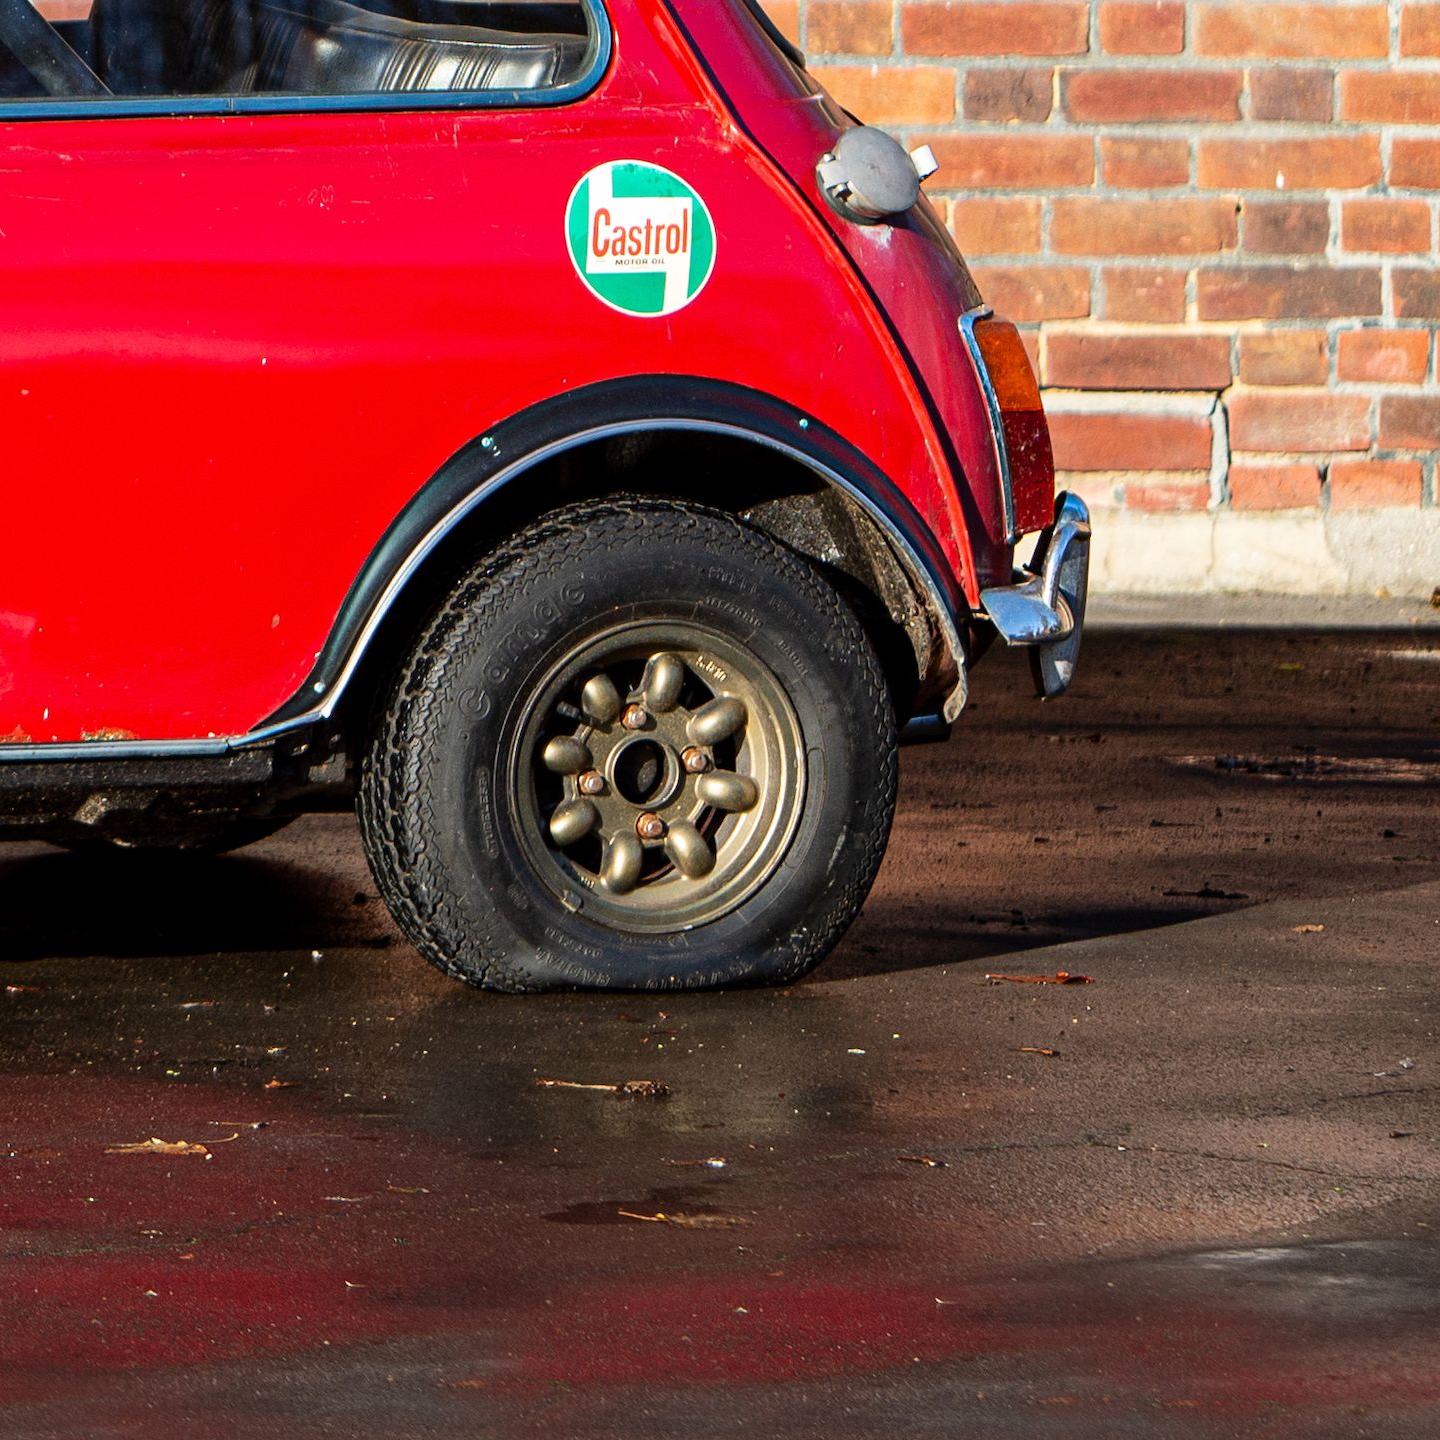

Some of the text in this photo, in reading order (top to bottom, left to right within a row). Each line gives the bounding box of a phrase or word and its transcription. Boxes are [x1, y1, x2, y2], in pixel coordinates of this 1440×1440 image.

[592, 207, 688, 258] Castrol
[615, 257, 666, 266] MOTOR OIL
[456, 582, 586, 721] Camac
